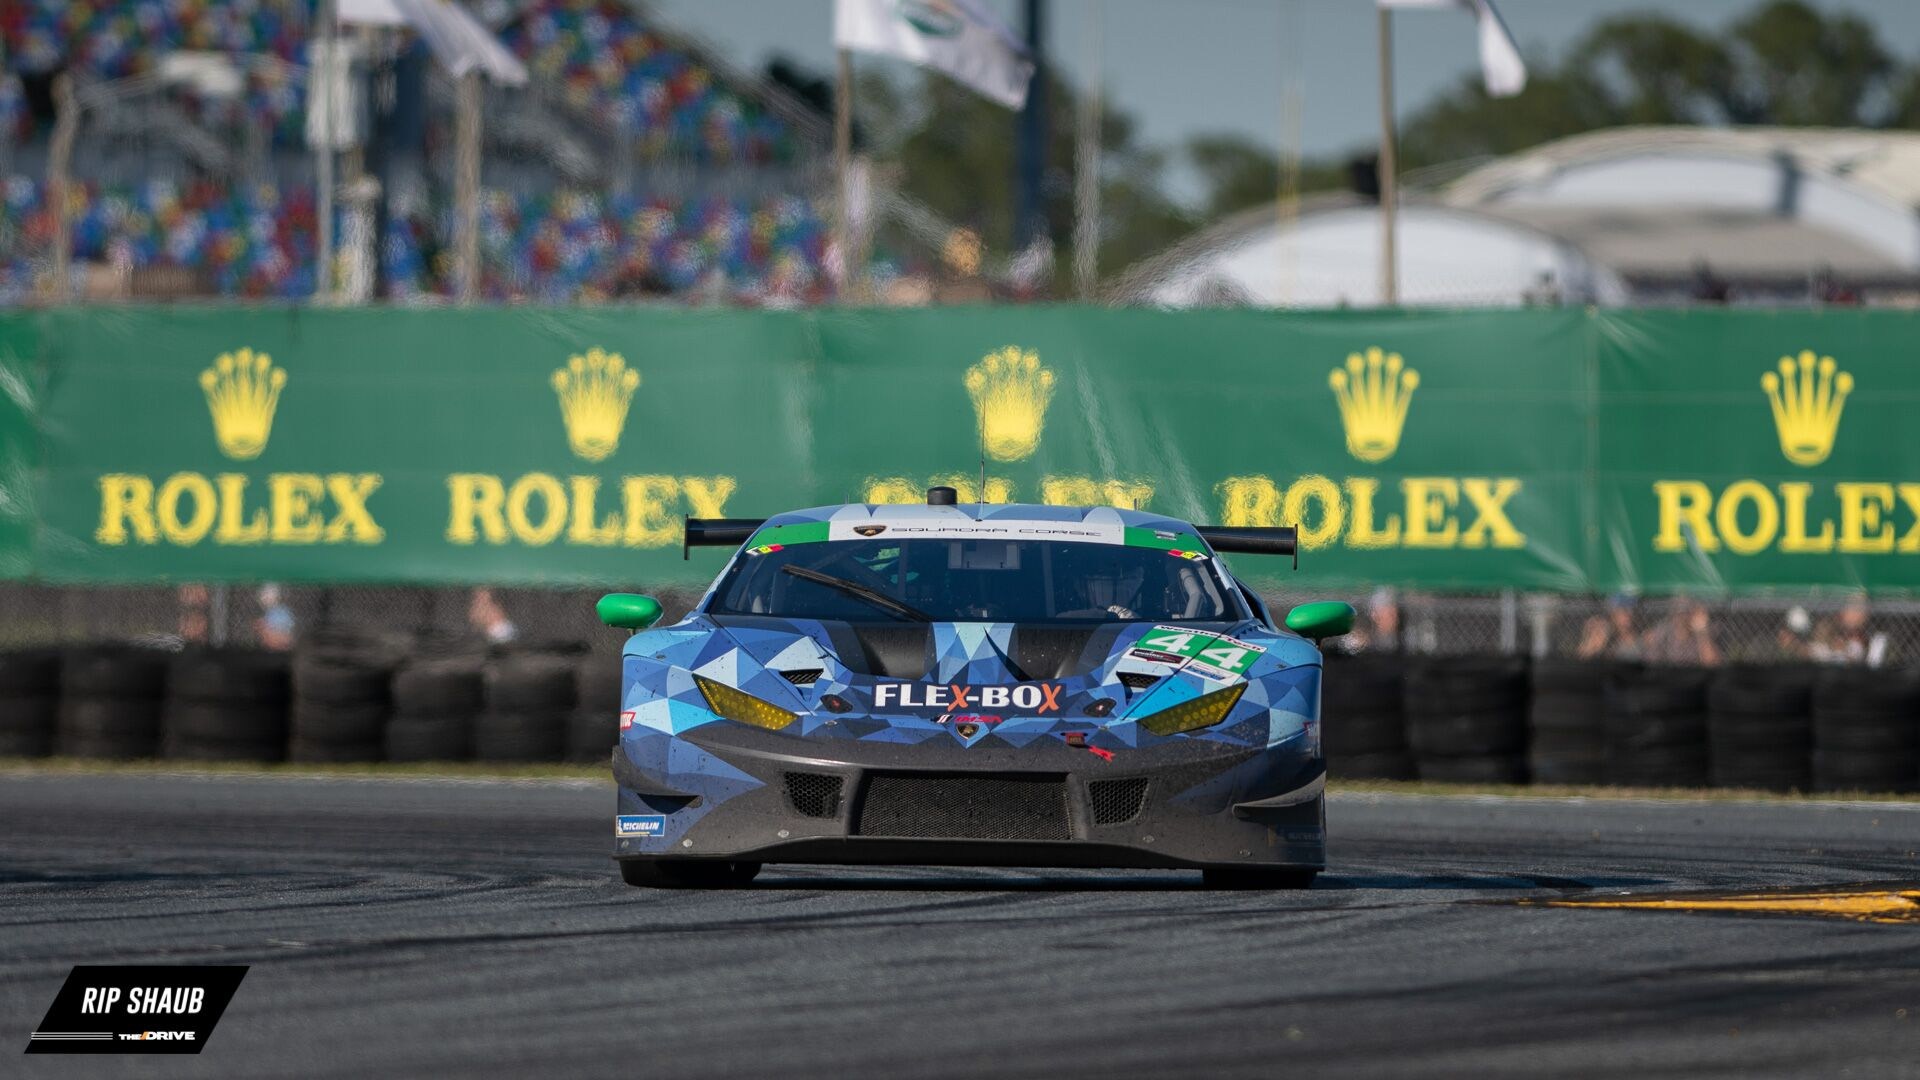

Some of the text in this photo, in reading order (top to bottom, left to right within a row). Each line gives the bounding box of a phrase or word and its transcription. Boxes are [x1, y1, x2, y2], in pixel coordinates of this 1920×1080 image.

[96, 473, 384, 546] ROLEX
[446, 473, 736, 547] ROLEX
[1217, 475, 1526, 549] ROLEX
[1019, 529, 1102, 537] CORSE
[1145, 633, 1248, 670] 44
[1160, 625, 1264, 652] WeatheTech
[874, 683, 1062, 714] FLEX-BOX
[622, 822, 660, 831] MICHELIN
